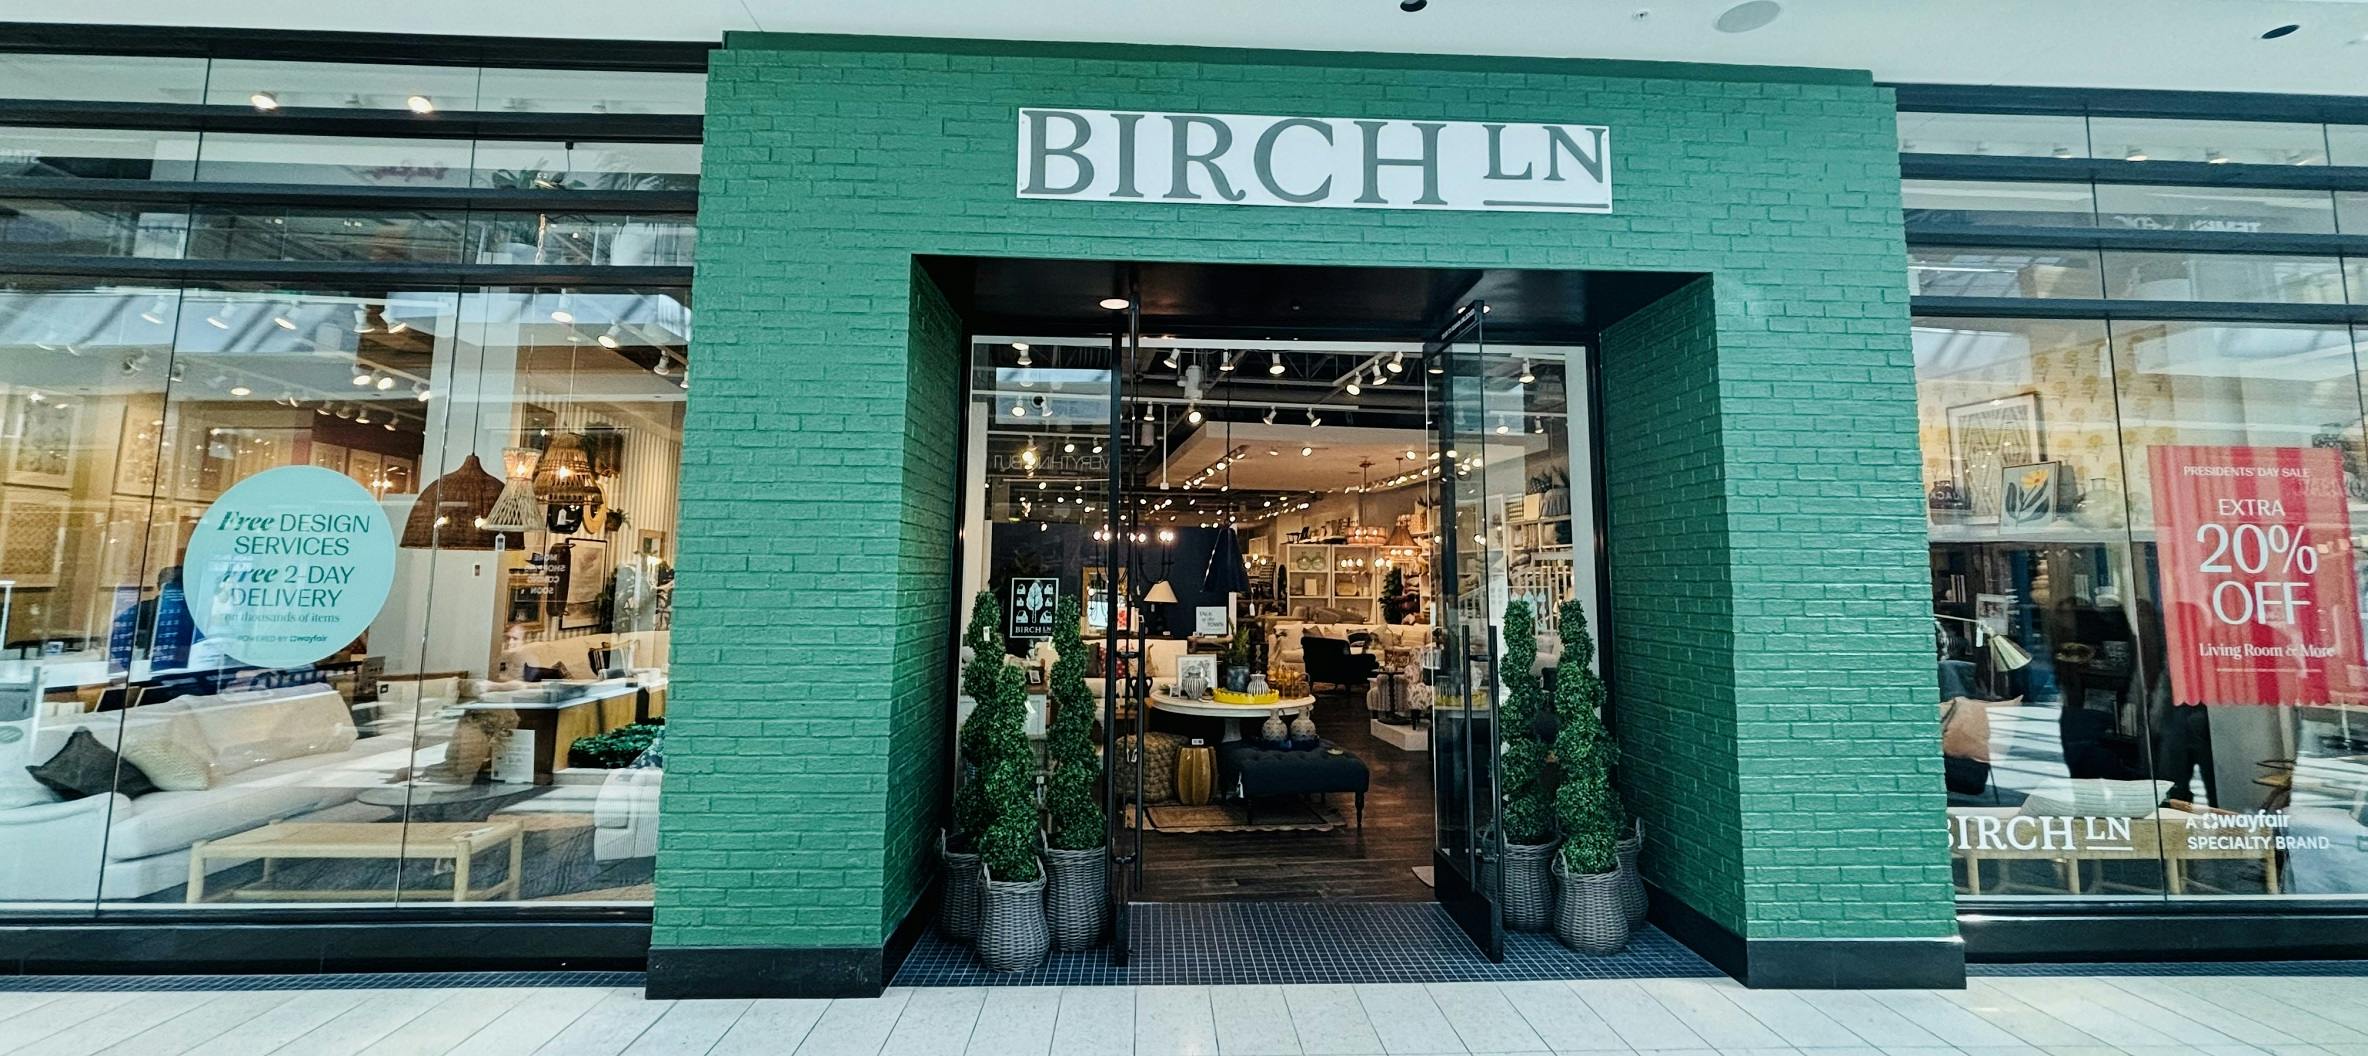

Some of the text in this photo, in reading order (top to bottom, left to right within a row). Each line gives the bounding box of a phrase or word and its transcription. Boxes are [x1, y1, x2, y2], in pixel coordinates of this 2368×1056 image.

[1020, 110, 1606, 205] BIRCH LN
[2257, 467, 2280, 477] DAY
[2282, 468, 2310, 478] SALE
[2218, 499, 2286, 516] EXTRA
[216, 511, 370, 533] Free DESIGN
[233, 536, 349, 556] SERVICES
[2196, 523, 2318, 574] 20%
[222, 564, 355, 584] Free 2-DAY
[231, 587, 343, 607] DELIVERY
[2212, 580, 2311, 625] OFF
[240, 612, 295, 622] thousands
[299, 612, 309, 622] of
[311, 613, 340, 623] items
[295, 635, 328, 643] wayfair
[2199, 643, 2242, 659] Living
[2244, 644, 2283, 657] Room
[2300, 645, 2336, 657] More
[2084, 816, 2132, 841] LN
[2185, 809, 2291, 832] A wayfair
[2187, 836, 2330, 850] SPECIALTY BRAND
